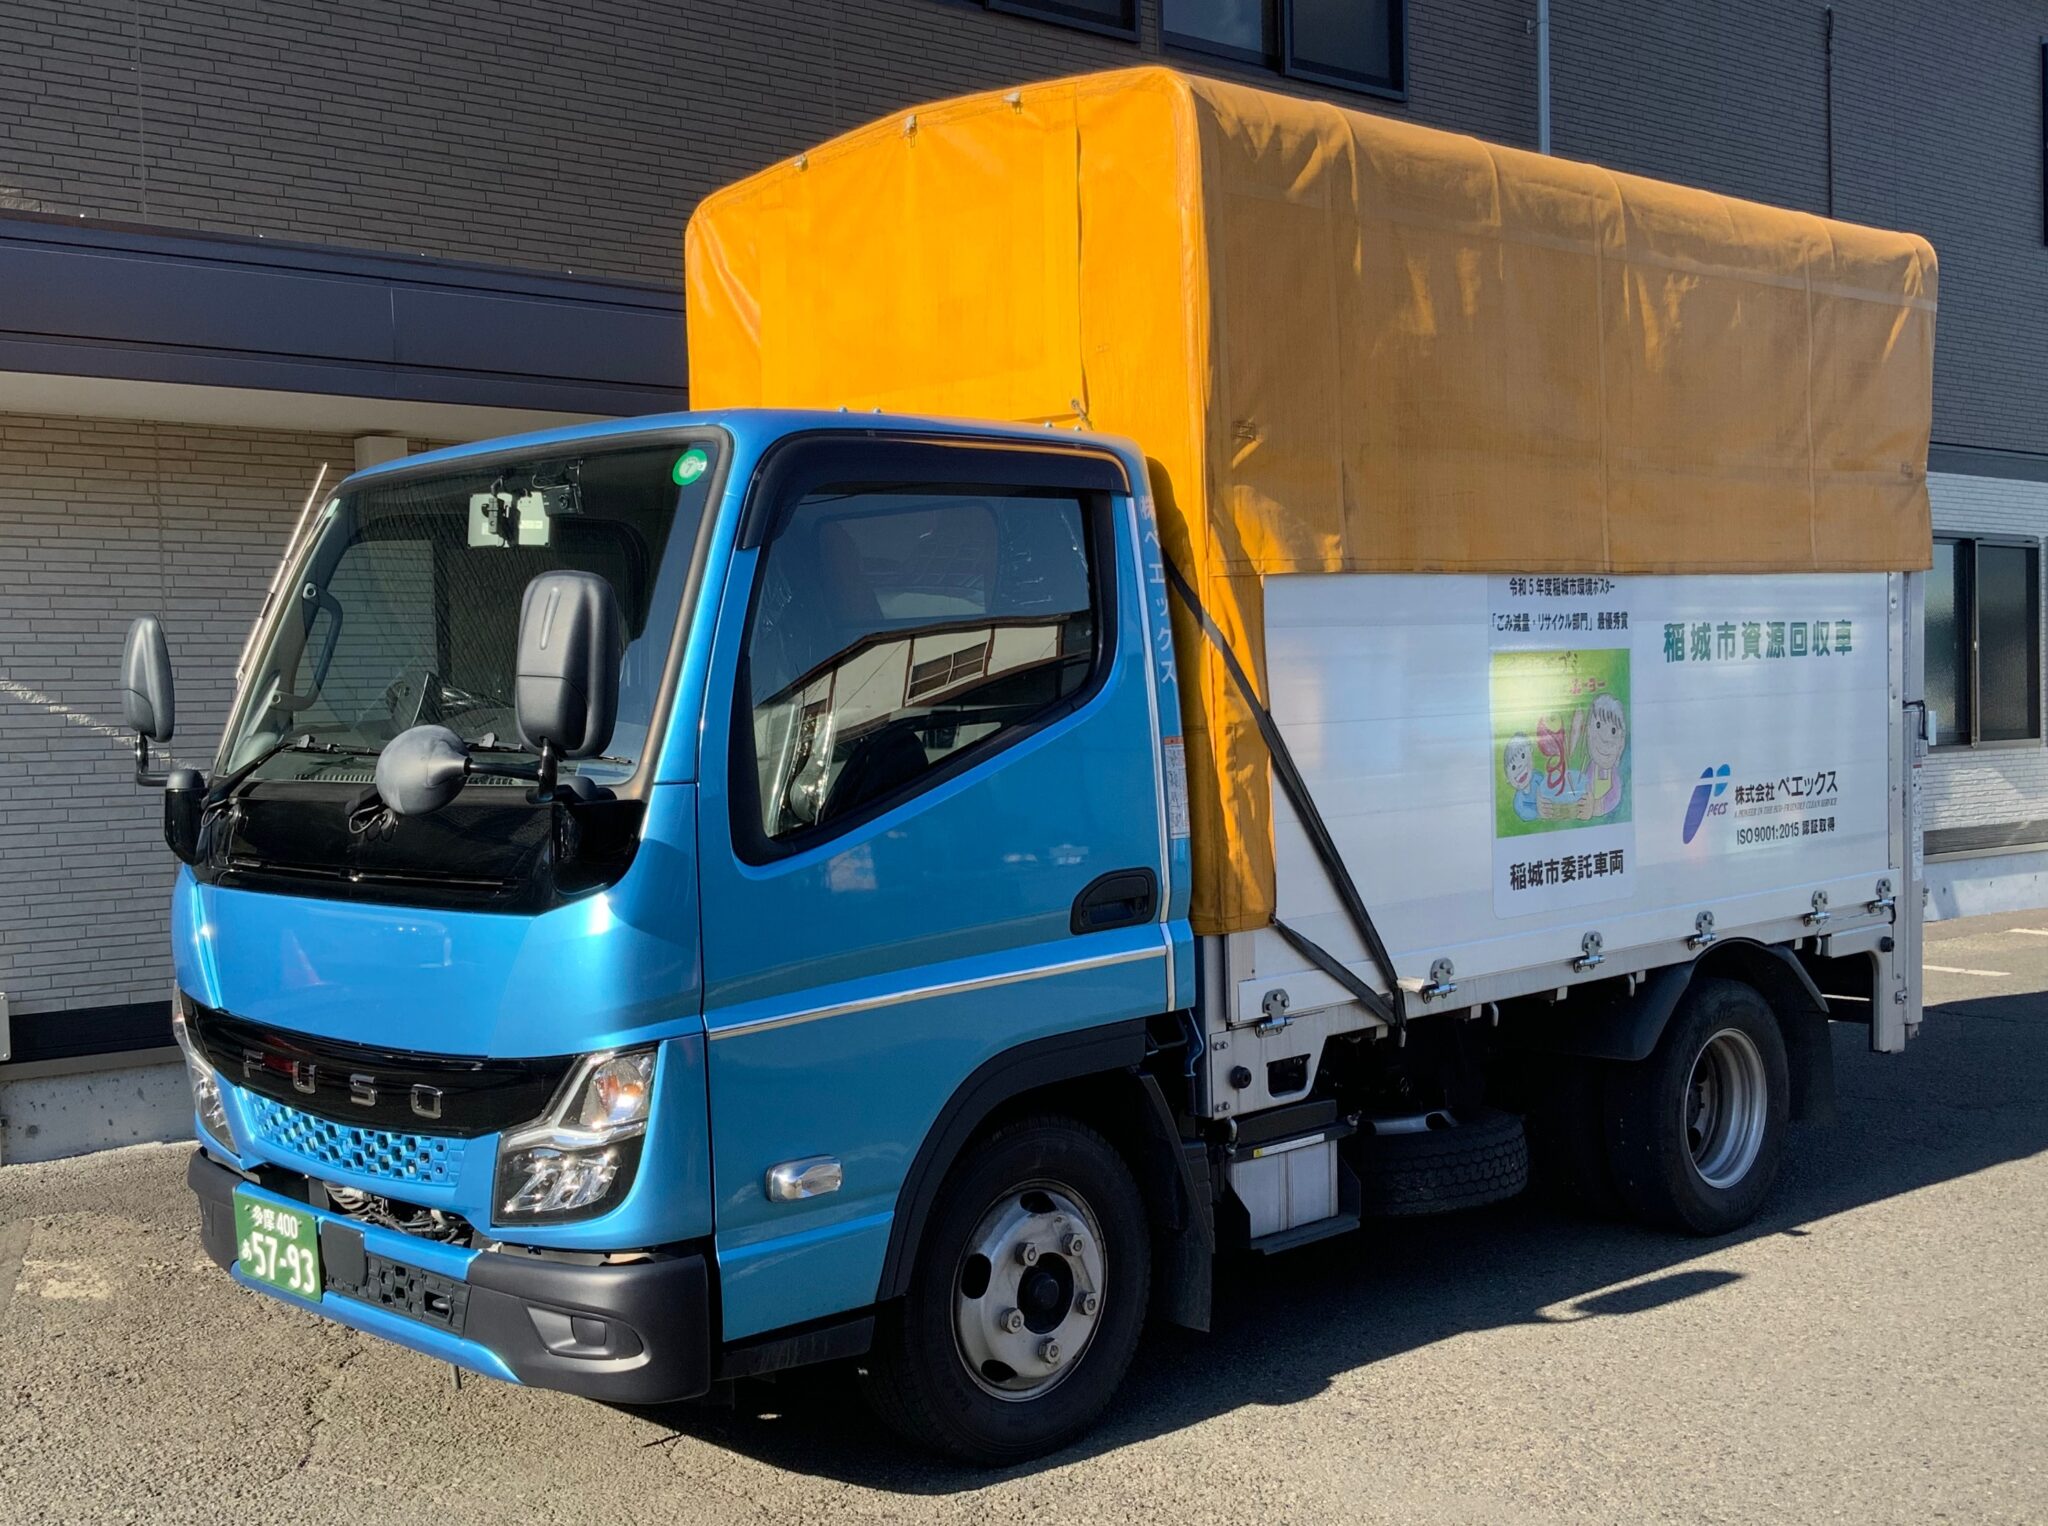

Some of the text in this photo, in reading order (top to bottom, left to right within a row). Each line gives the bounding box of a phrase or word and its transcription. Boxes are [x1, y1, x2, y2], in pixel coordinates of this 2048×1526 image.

[1663, 619, 1852, 663] 稲城市資源回収車
[1706, 802, 1729, 817] PECS
[1509, 849, 1624, 891] 稲城市委託車両
[243, 1049, 443, 1119] FUSO
[277, 1212, 298, 1239] 400
